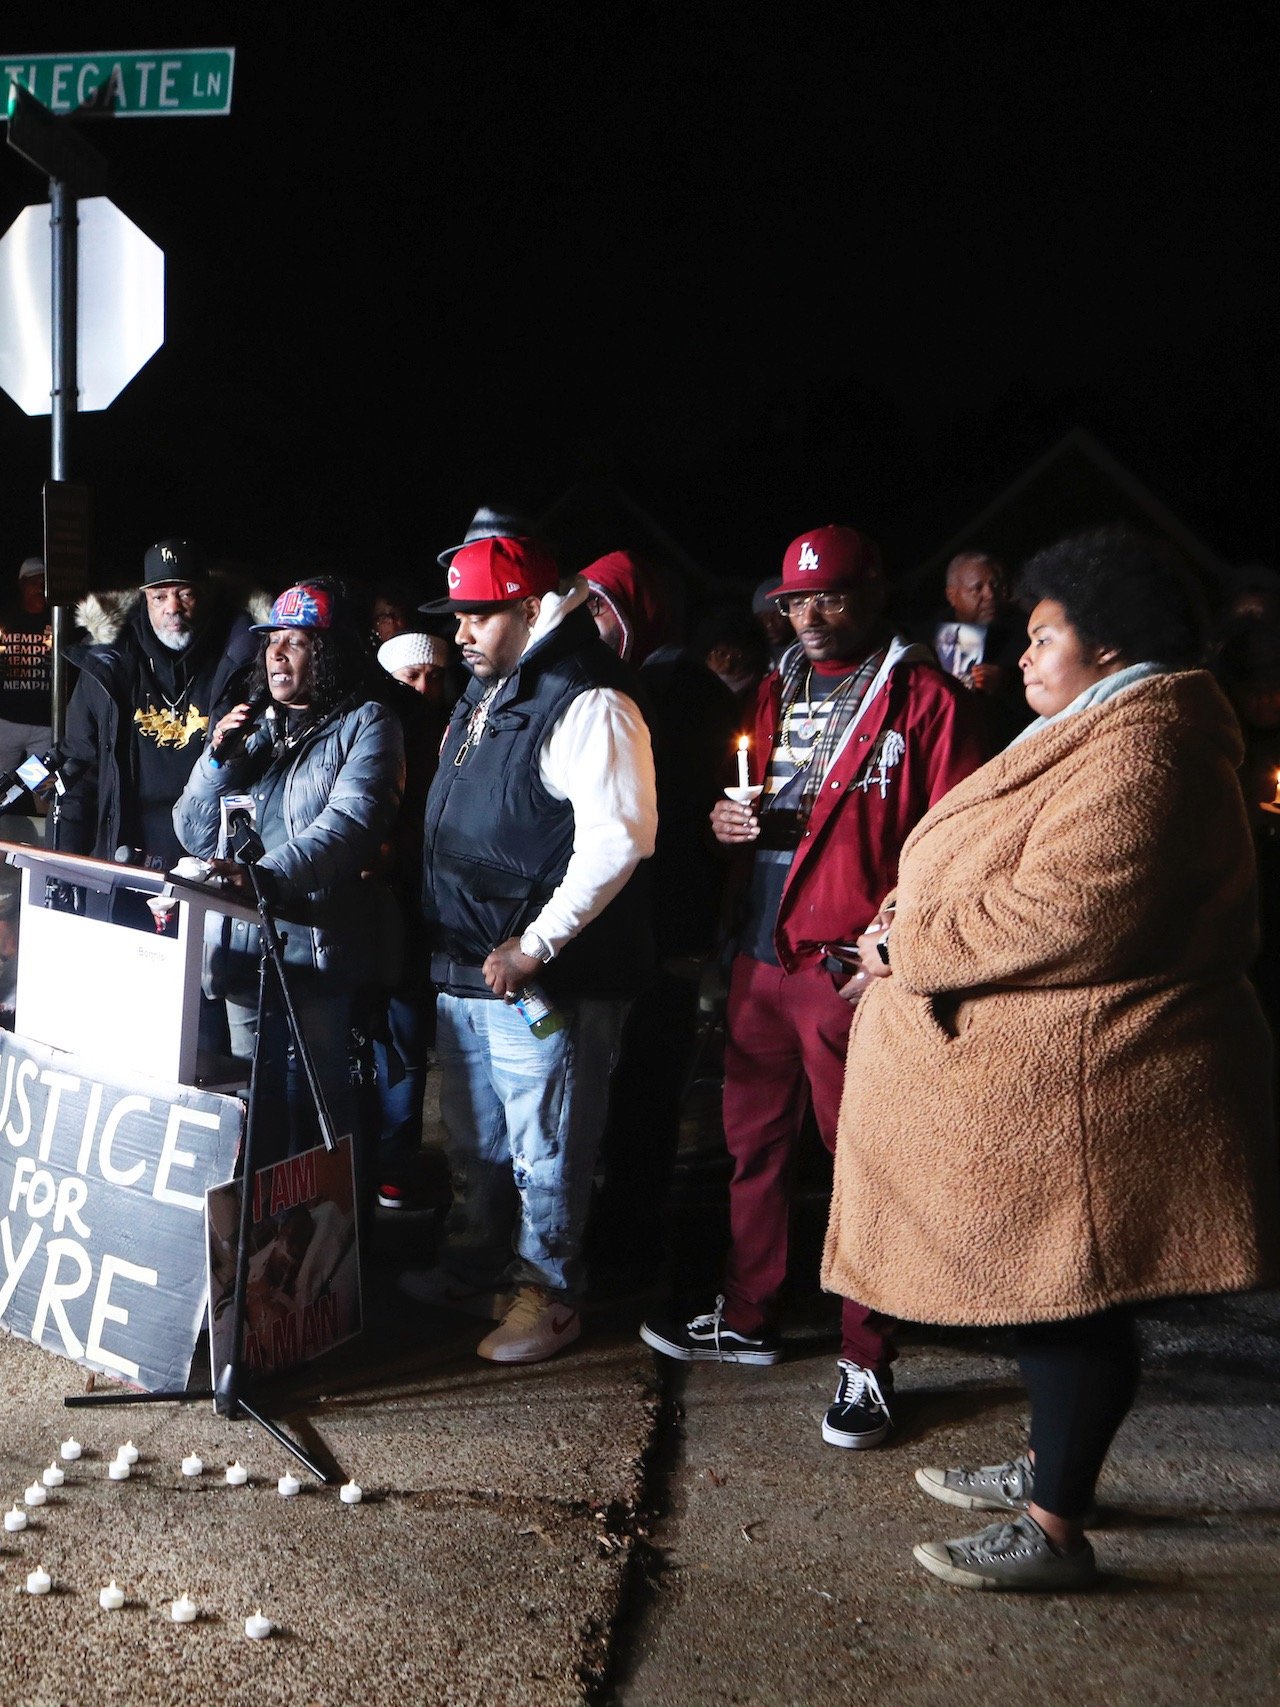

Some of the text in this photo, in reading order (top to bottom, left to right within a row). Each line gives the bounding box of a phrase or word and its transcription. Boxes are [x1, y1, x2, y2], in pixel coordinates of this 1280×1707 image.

[193, 72, 221, 97] LN
[447, 566, 461, 589] C
[798, 542, 819, 571] LA
[9, 1156, 92, 1239] FOR
[252, 1151, 318, 1224] I AM
[243, 1291, 341, 1370] A MAN
